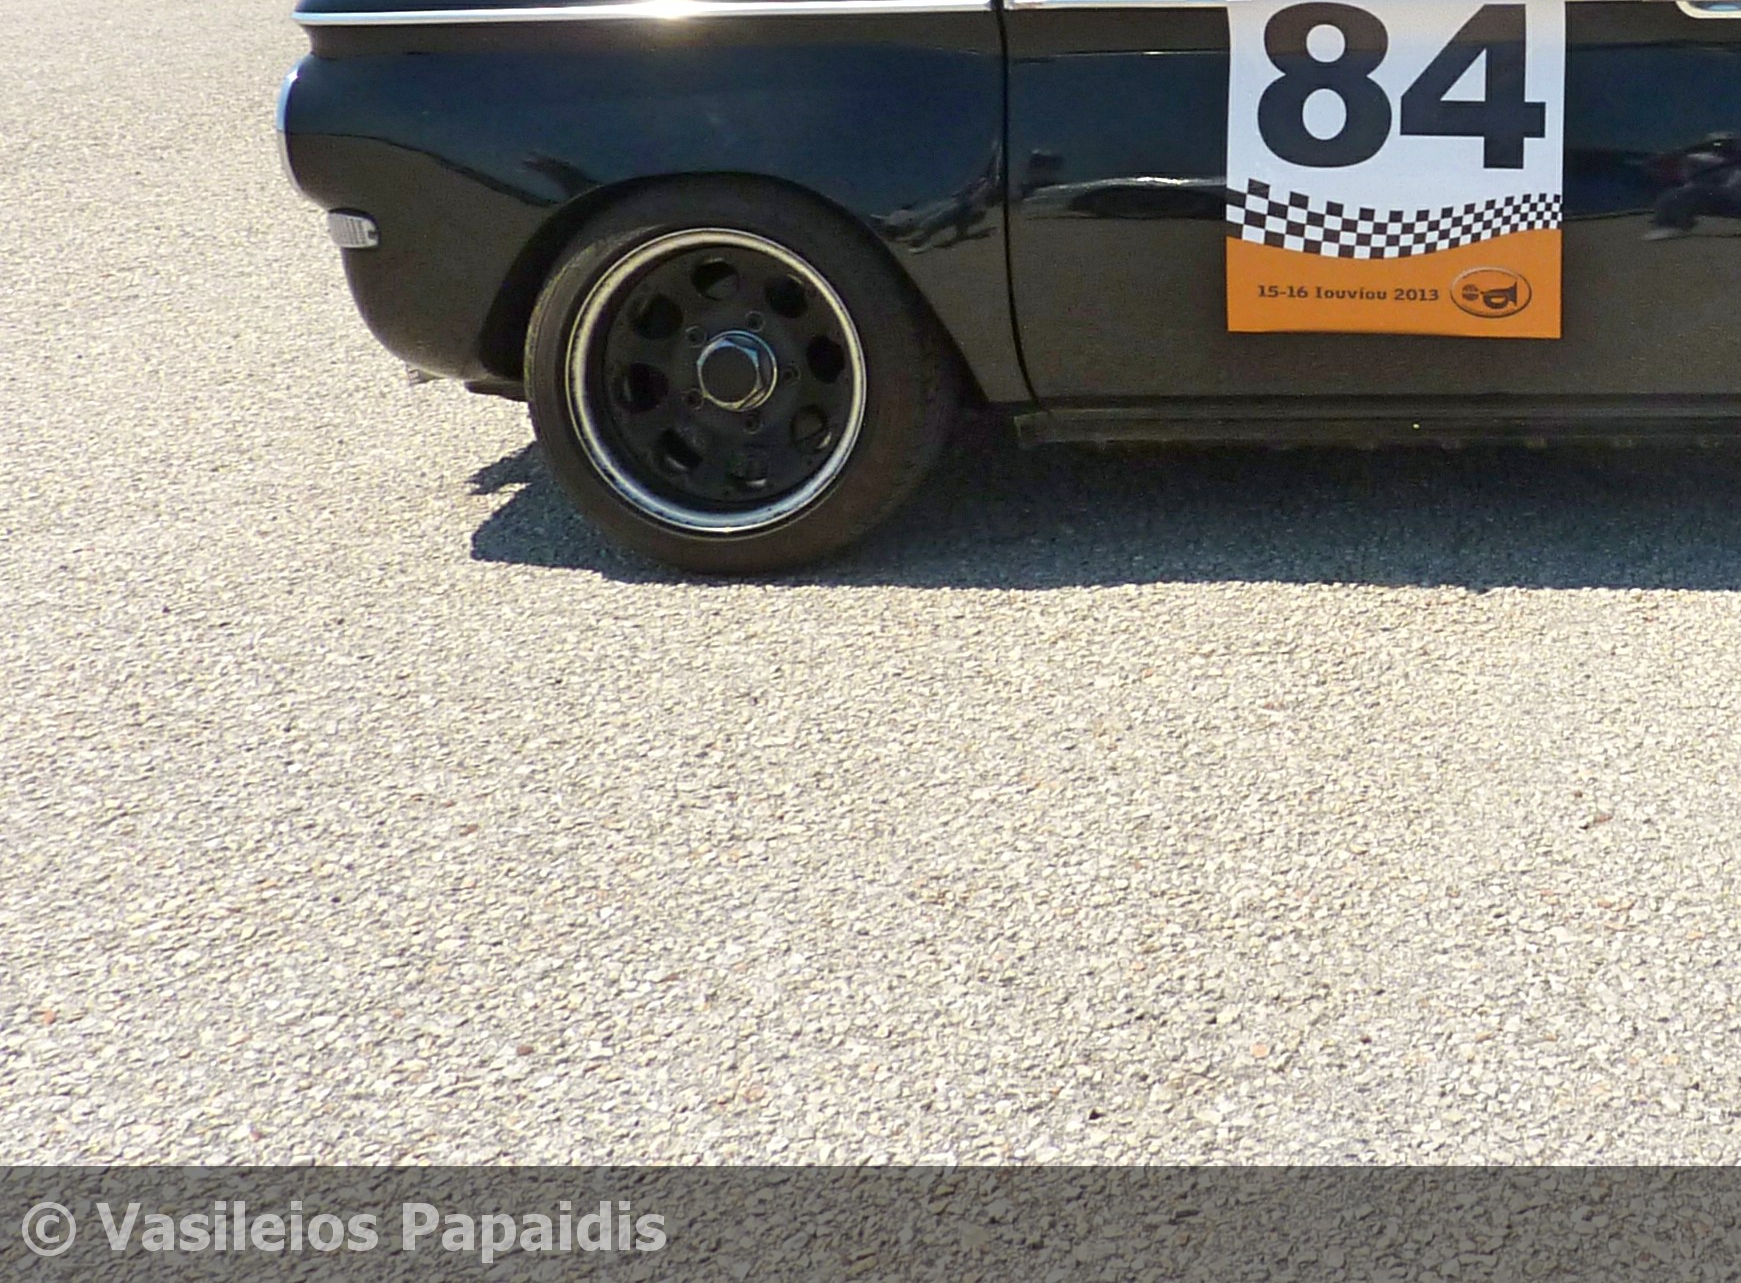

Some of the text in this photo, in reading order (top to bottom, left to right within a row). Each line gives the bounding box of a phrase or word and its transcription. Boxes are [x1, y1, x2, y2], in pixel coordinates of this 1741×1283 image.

[1257, 1, 1546, 170] 84
[1258, 285, 1439, 301] 15-16 Ιουνίου 2013
